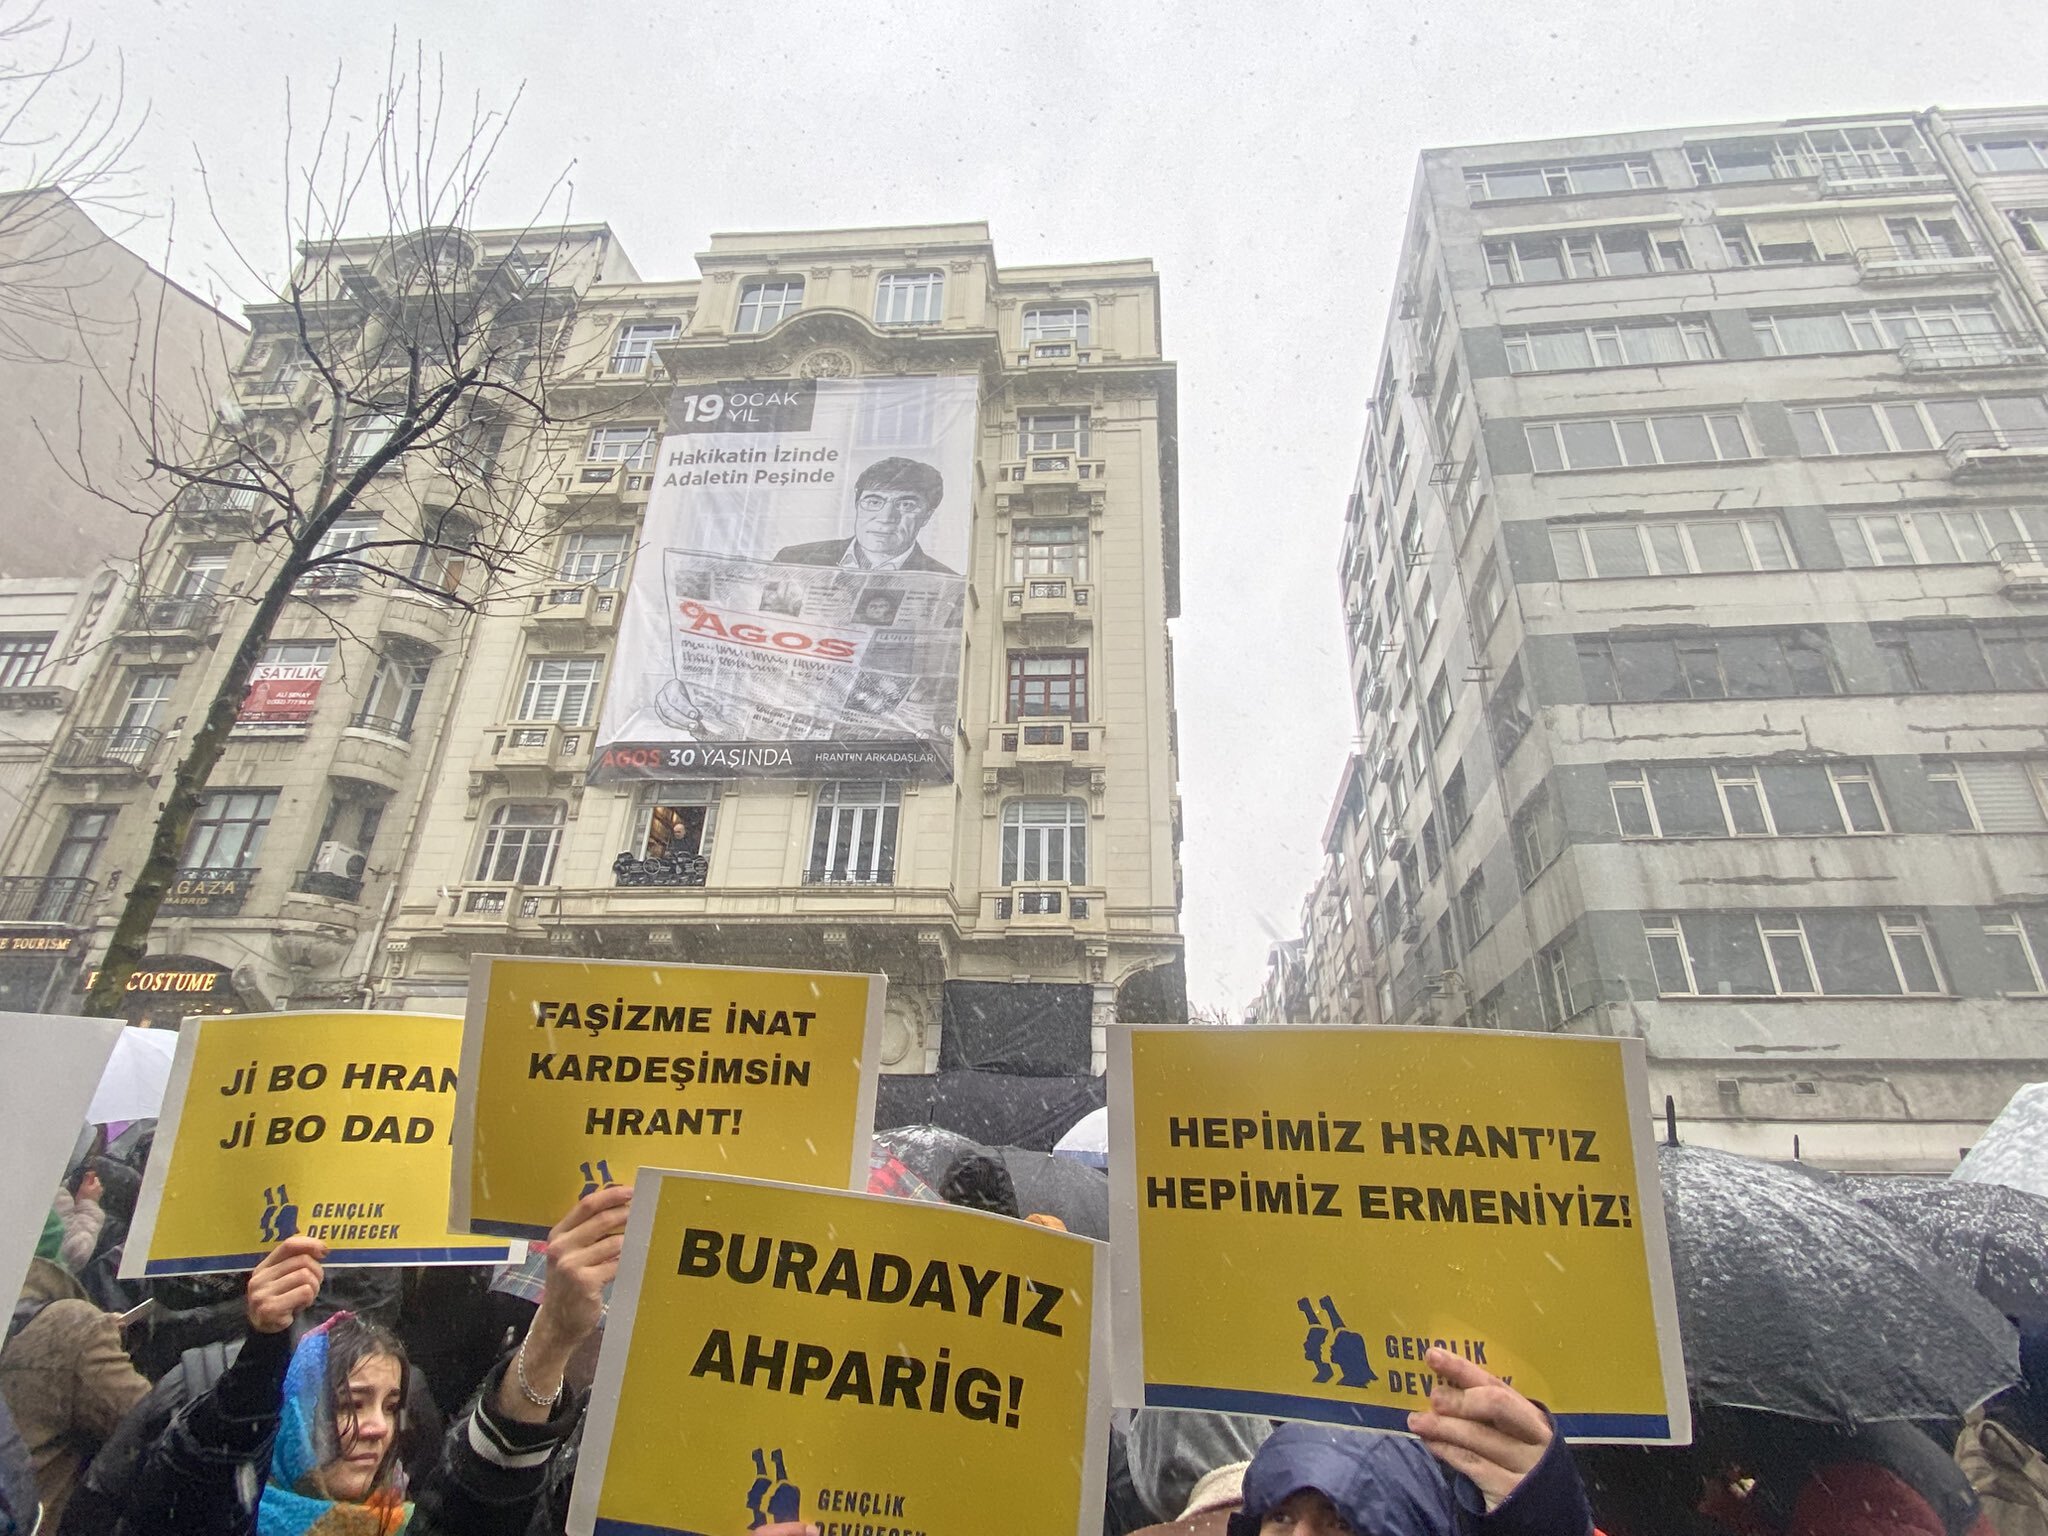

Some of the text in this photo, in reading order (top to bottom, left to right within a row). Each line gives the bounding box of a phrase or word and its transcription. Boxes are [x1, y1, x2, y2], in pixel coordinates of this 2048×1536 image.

[683, 392, 800, 423] 19 OCAK
[729, 409, 760, 422] YIL
[668, 445, 839, 467] Hakikatin İzinde
[663, 468, 835, 487] Adaletin Peşinde
[689, 611, 858, 658] AGOS
[261, 667, 323, 679] SATILIK
[602, 750, 661, 769] AGOS
[668, 749, 696, 766] 30
[701, 748, 793, 768] YAŞINDA
[864, 752, 937, 764] ARKADAŞLARI
[163, 897, 208, 905] MADRID
[166, 880, 235, 895] GAZA
[126, 972, 217, 992] COSTUME
[536, 998, 816, 1037] FAŞİZME İNAT
[220, 1061, 257, 1097] Jİ
[268, 1063, 327, 1092] BO
[529, 1050, 811, 1091] KARDEŞİMSİN
[220, 1112, 256, 1150] Jİ
[266, 1115, 326, 1145] BO
[341, 1116, 434, 1144] DAD
[585, 1107, 743, 1136] HRANT!
[1169, 1110, 1600, 1163] HEPİMİZ HRANT'IZ
[312, 1203, 385, 1220] GENÇLİK
[1147, 1171, 1632, 1228] HEPİMİZ ERMENİYİZ!
[307, 1224, 400, 1239] DEVİRECEK
[677, 1227, 1064, 1337] BURADAYIZ
[689, 1329, 1025, 1429] AHPARİG!
[817, 1489, 906, 1517] GENÇLİK
